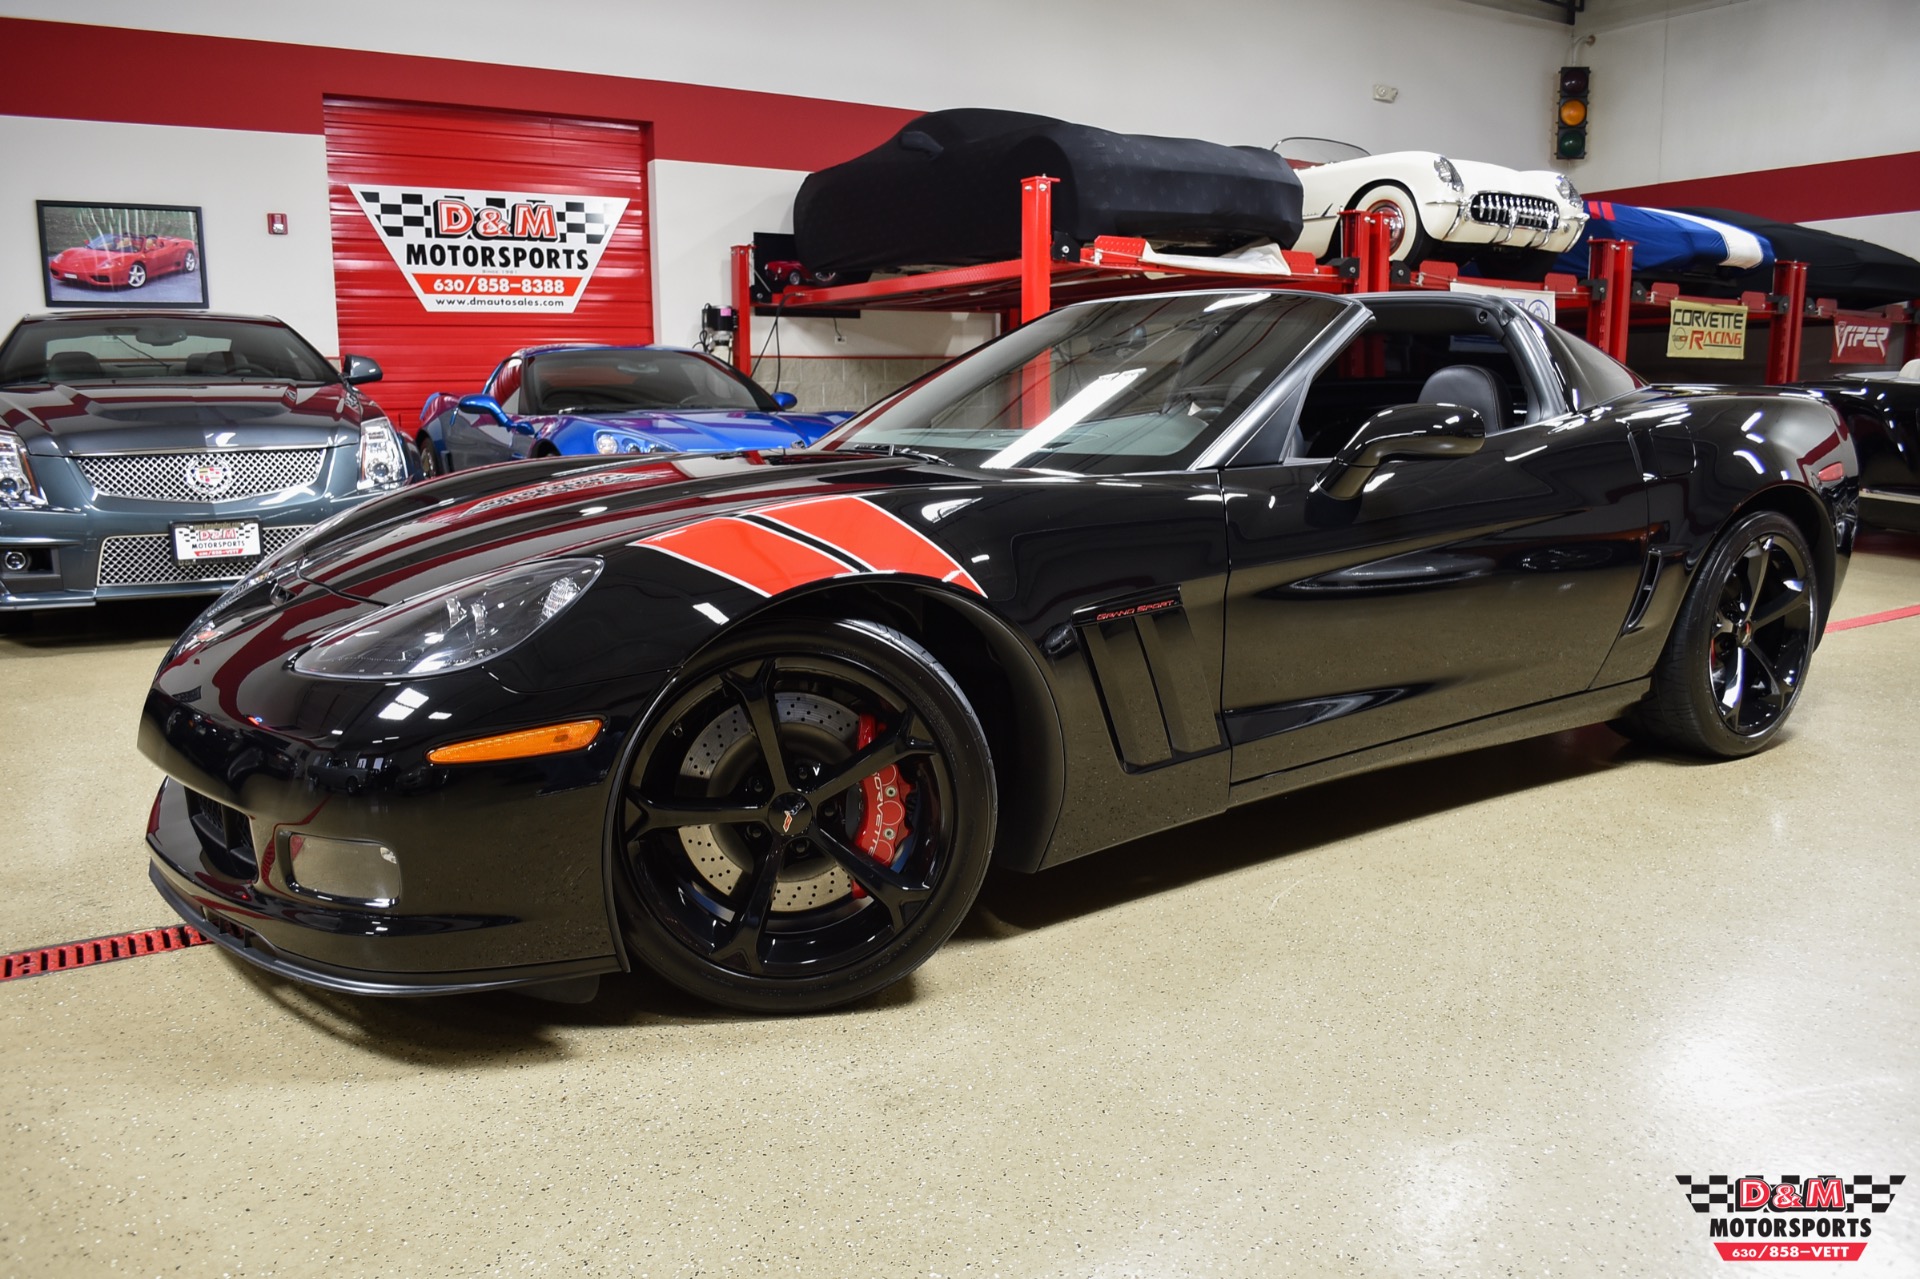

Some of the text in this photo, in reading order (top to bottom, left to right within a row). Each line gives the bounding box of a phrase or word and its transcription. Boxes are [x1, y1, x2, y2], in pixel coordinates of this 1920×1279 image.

[434, 199, 558, 240] D&M
[406, 243, 589, 270] MOTORSPORTS
[433, 276, 565, 294] 630/858-8388
[435, 297, 565, 307] www.dmautosales.com
[1673, 308, 1744, 330] CORVETTE
[1689, 330, 1743, 350] RACING
[1834, 324, 1890, 358] VIPER
[192, 541, 245, 549] MOTORSPORTS
[199, 529, 236, 541] D&M
[1096, 600, 1175, 621] GRAND SPORT
